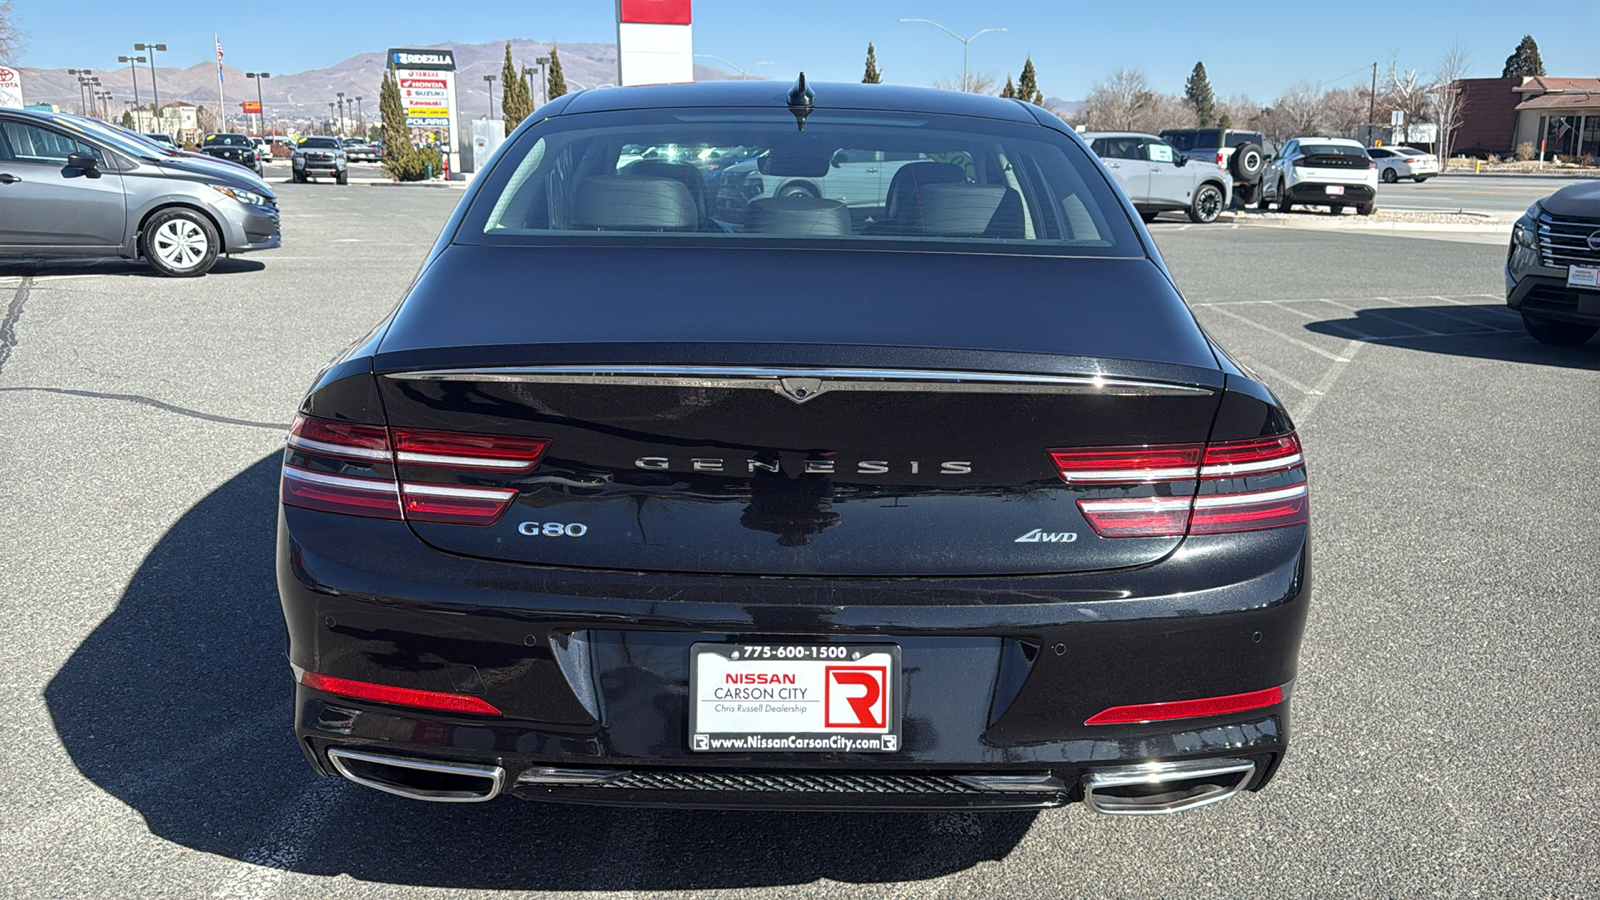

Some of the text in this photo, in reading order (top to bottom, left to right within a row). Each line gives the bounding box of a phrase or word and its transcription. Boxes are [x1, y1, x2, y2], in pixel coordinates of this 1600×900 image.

[407, 54, 452, 64] RIDEZILLA
[634, 457, 973, 474] GENESIS
[518, 521, 588, 537] G80
[744, 646, 847, 658] 775-600-1500
[725, 673, 796, 684] NISSAN
[714, 687, 808, 699] CARSON CITY
[714, 704, 807, 715] Chris Russell Dealership
[710, 735, 881, 752] www.NissanCarsonCity.com
